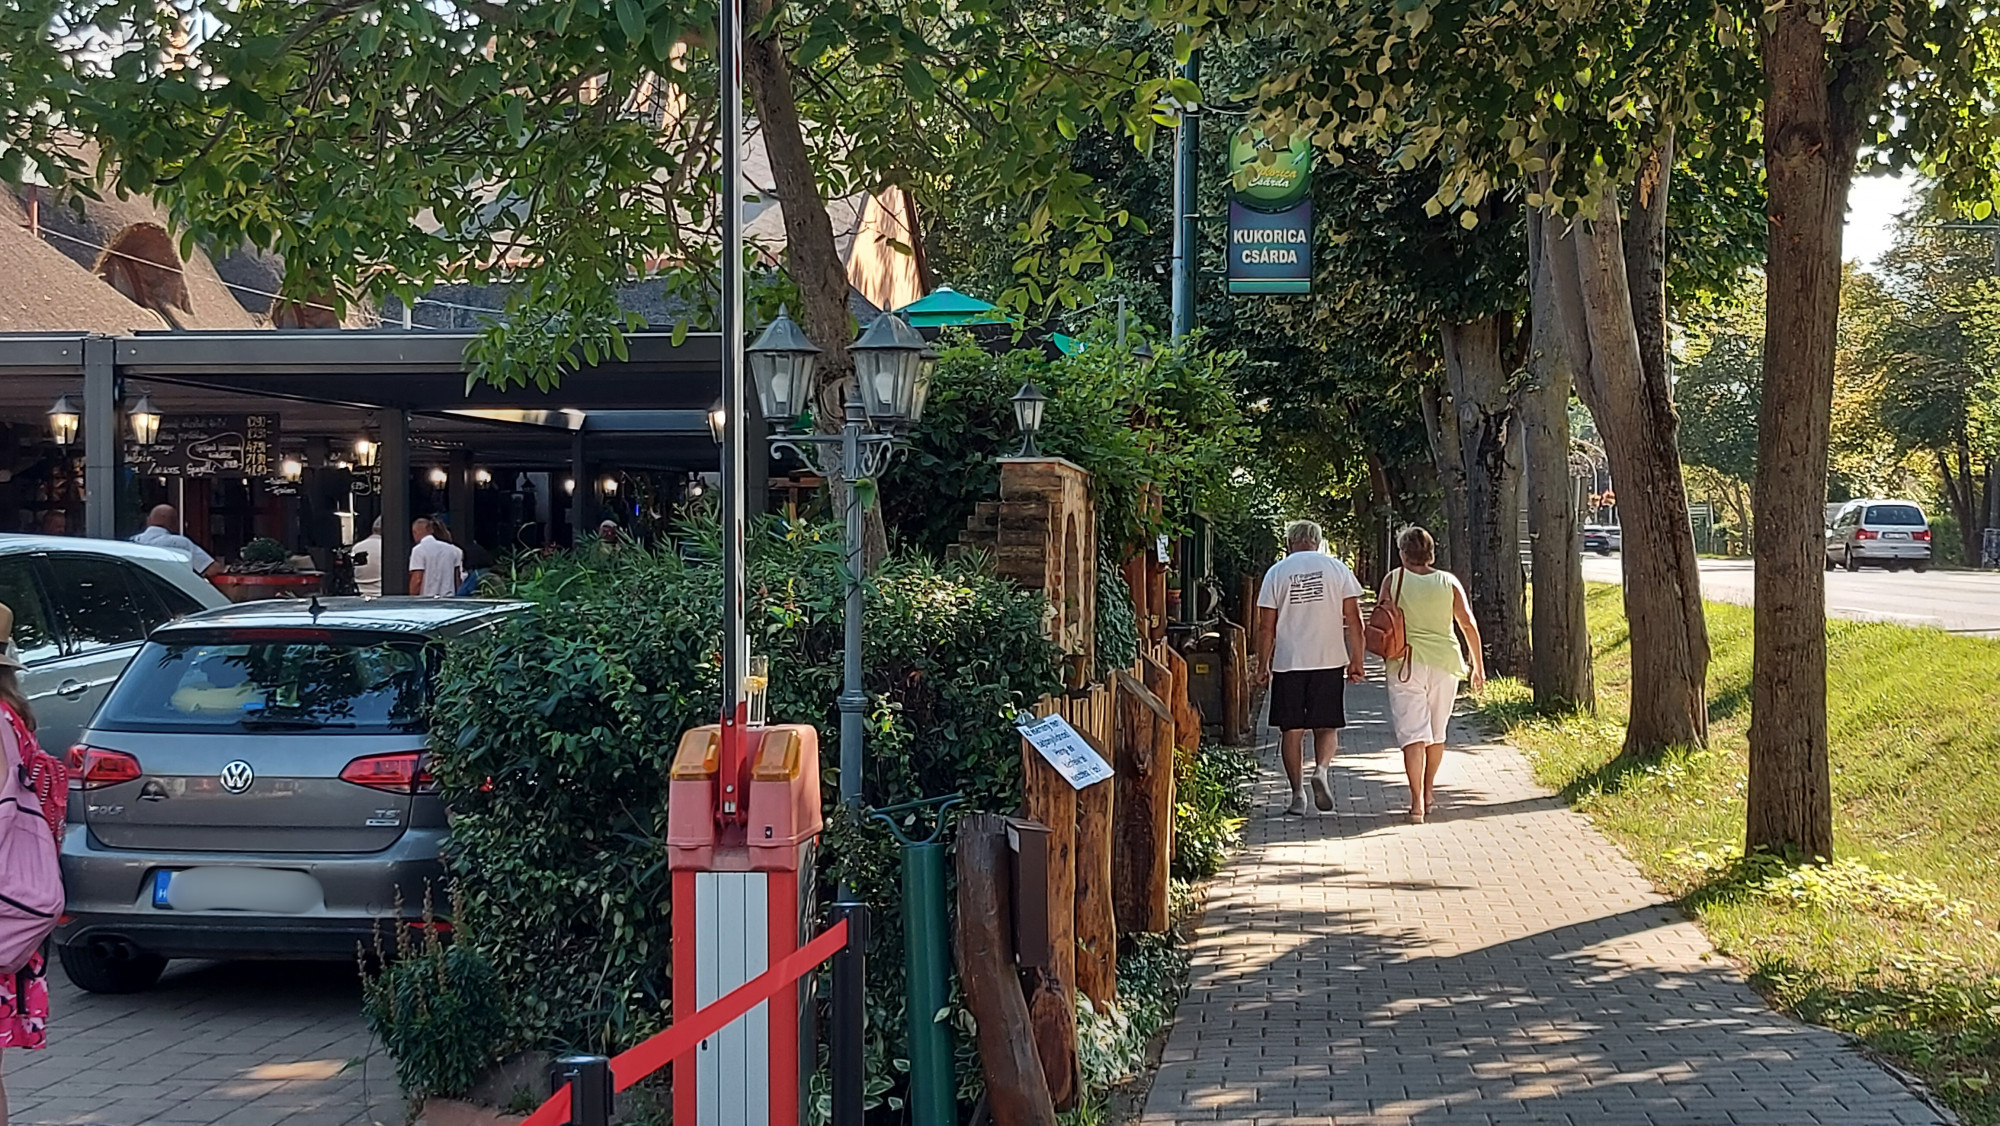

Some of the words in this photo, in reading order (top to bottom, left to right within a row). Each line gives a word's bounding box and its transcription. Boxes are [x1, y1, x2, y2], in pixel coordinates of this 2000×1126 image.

[1254, 164, 1298, 178] ukorica
[1233, 228, 1307, 244] KUKORICA
[1241, 245, 1298, 264] CSÁRDA
